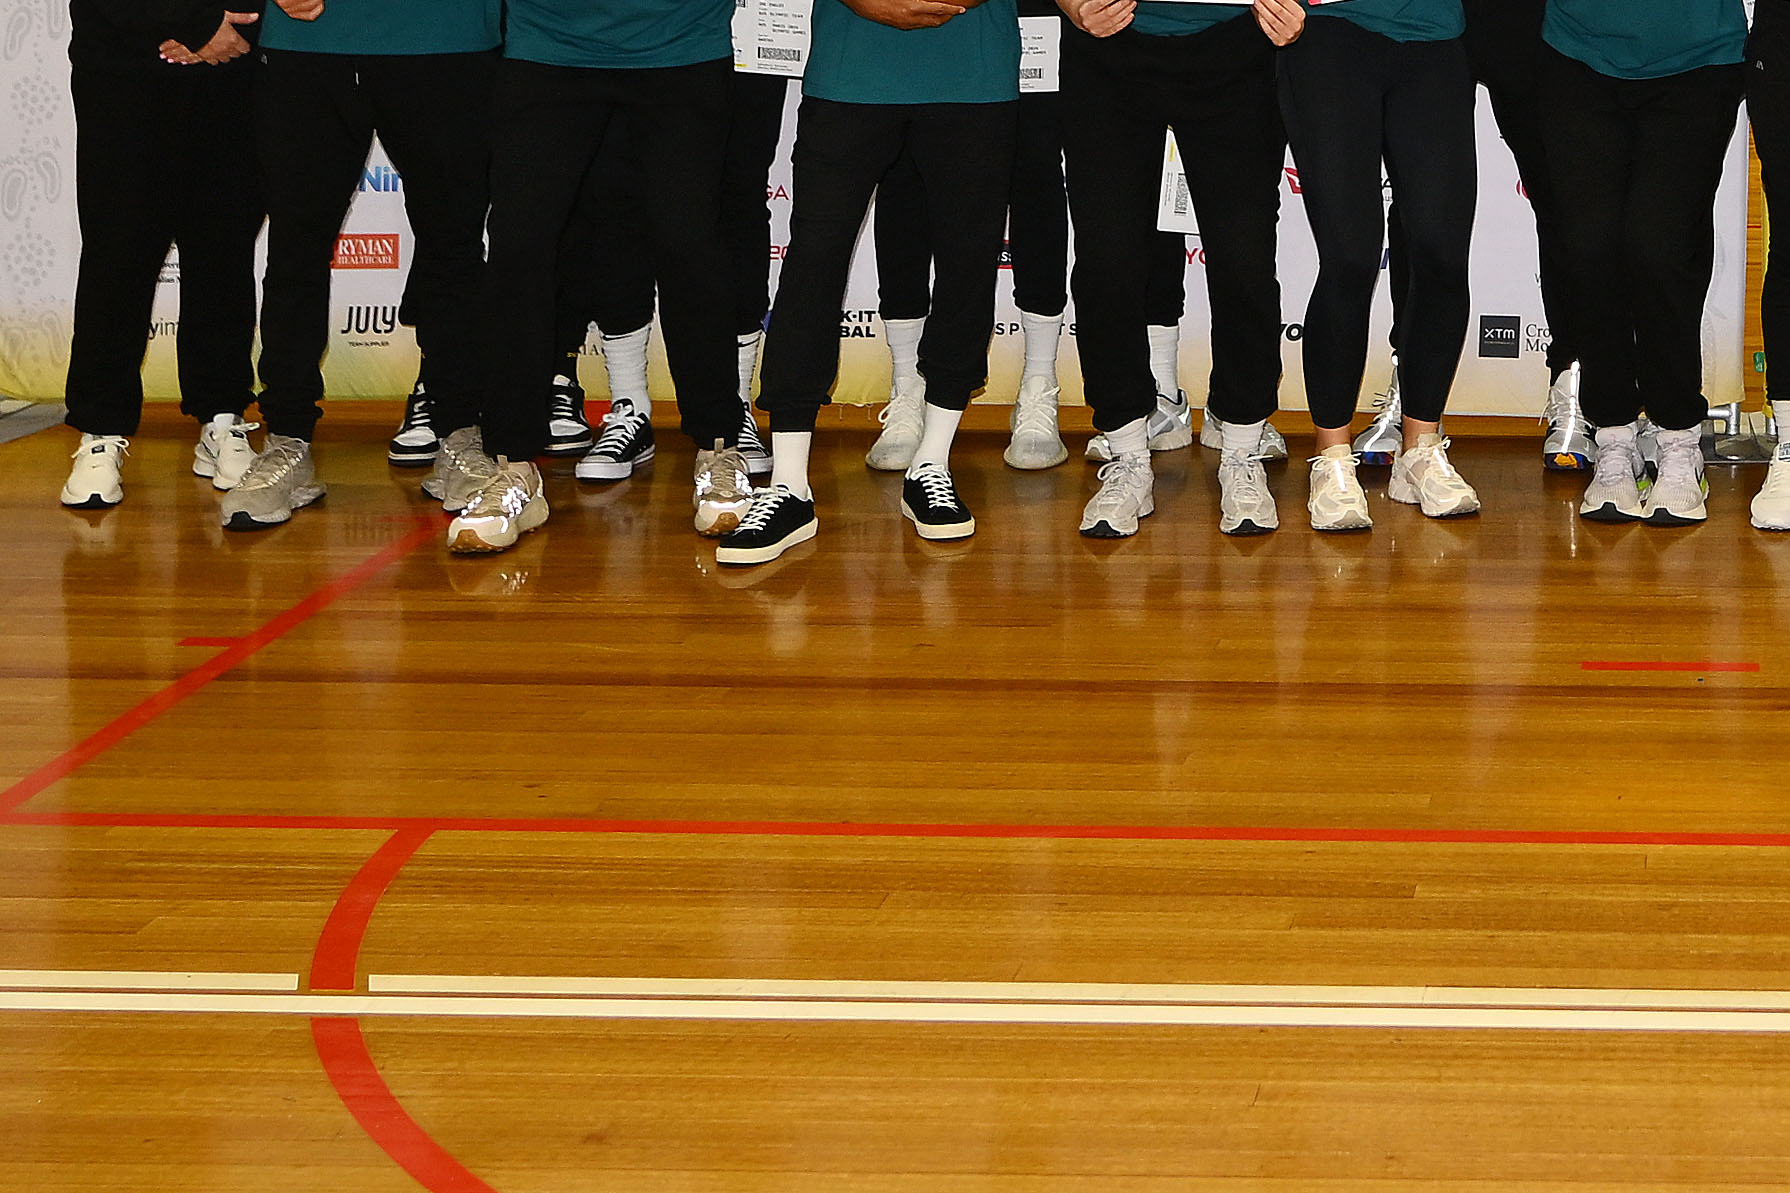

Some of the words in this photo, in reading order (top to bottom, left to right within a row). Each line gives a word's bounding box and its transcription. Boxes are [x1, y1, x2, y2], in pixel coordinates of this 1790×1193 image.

[338, 238, 394, 256] RYMAN
[340, 305, 397, 335] JULY
[1484, 328, 1515, 339] XTM
